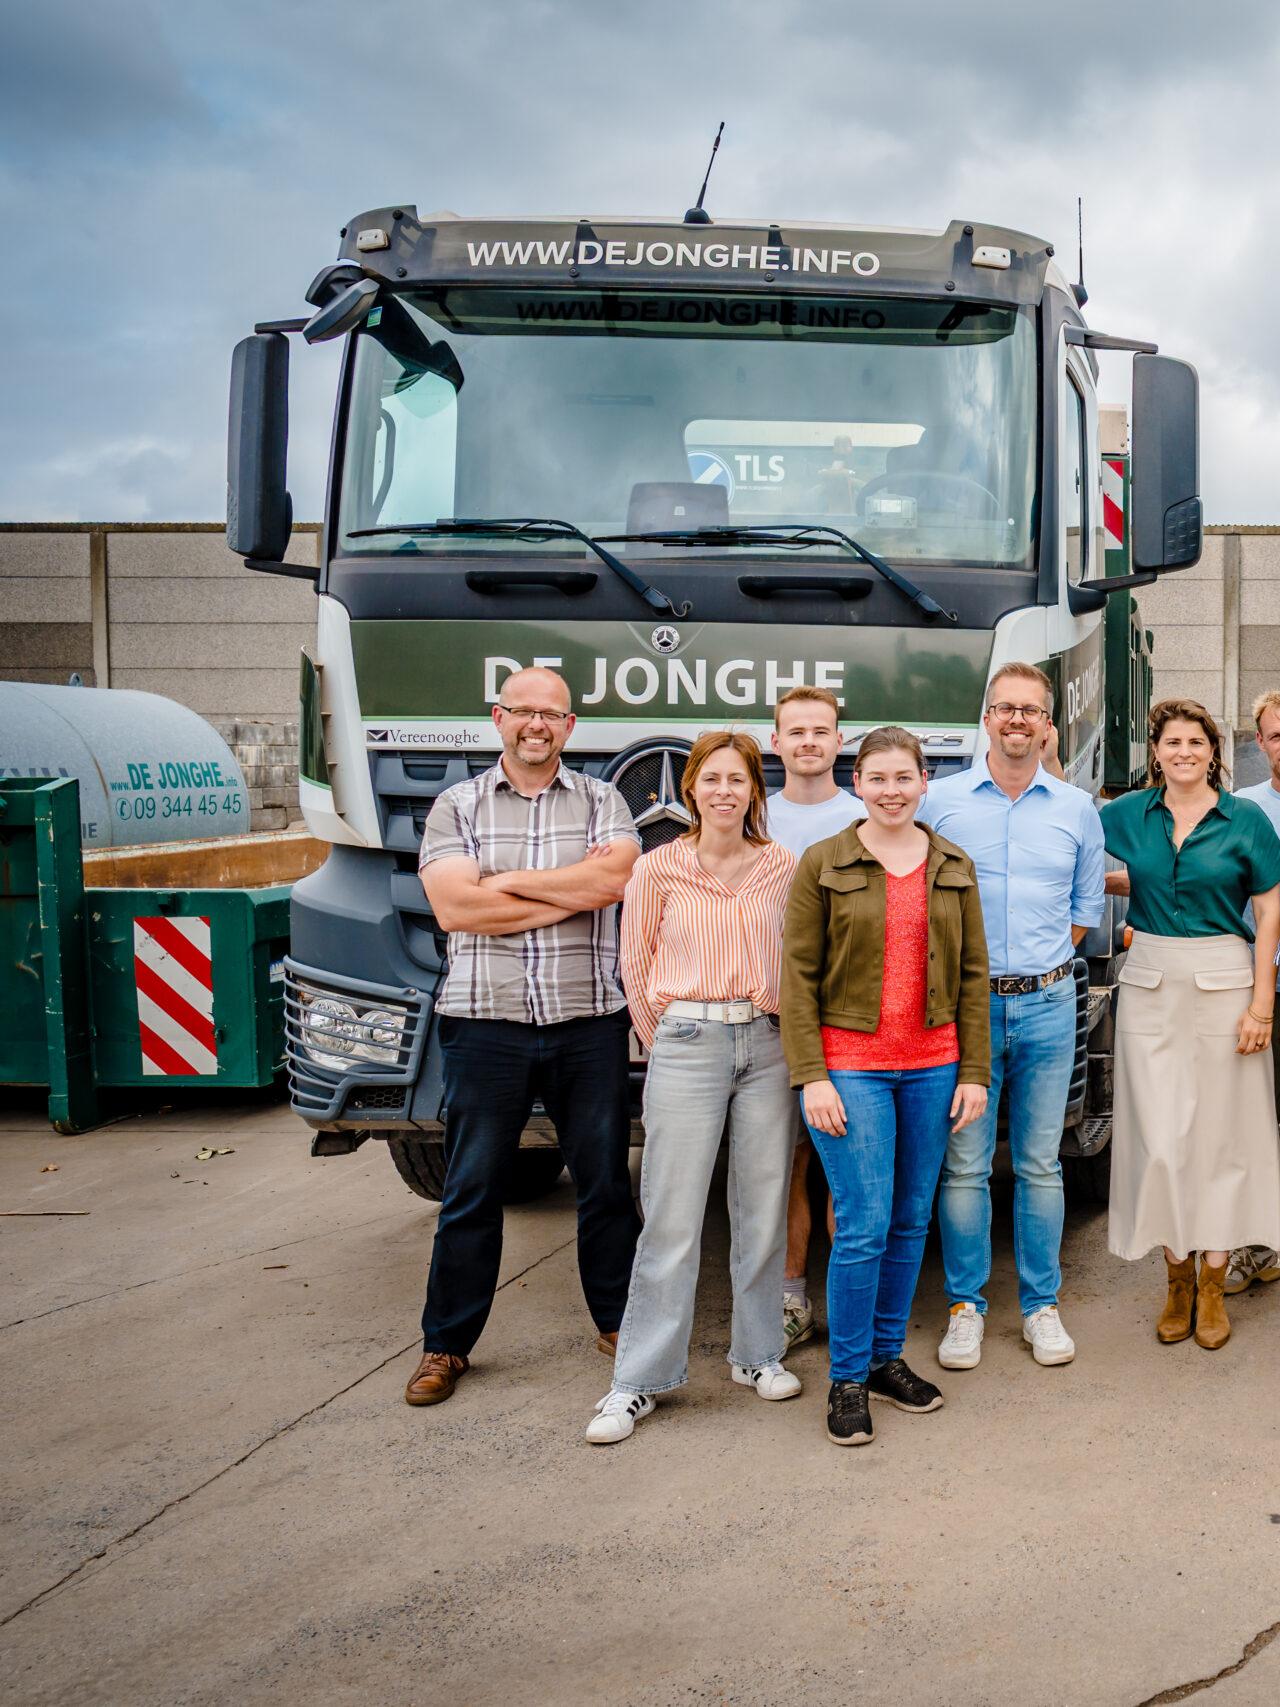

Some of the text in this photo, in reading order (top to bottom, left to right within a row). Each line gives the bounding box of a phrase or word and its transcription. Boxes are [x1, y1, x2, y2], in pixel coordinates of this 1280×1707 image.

[467, 240, 880, 276] WWW.DEJONGHE.INFO
[516, 300, 886, 329] WWWDEJONGHE.INFO
[734, 455, 785, 482] TLS
[390, 729, 479, 747] Vereenooghe
[134, 794, 241, 819] 09 344 45 45
